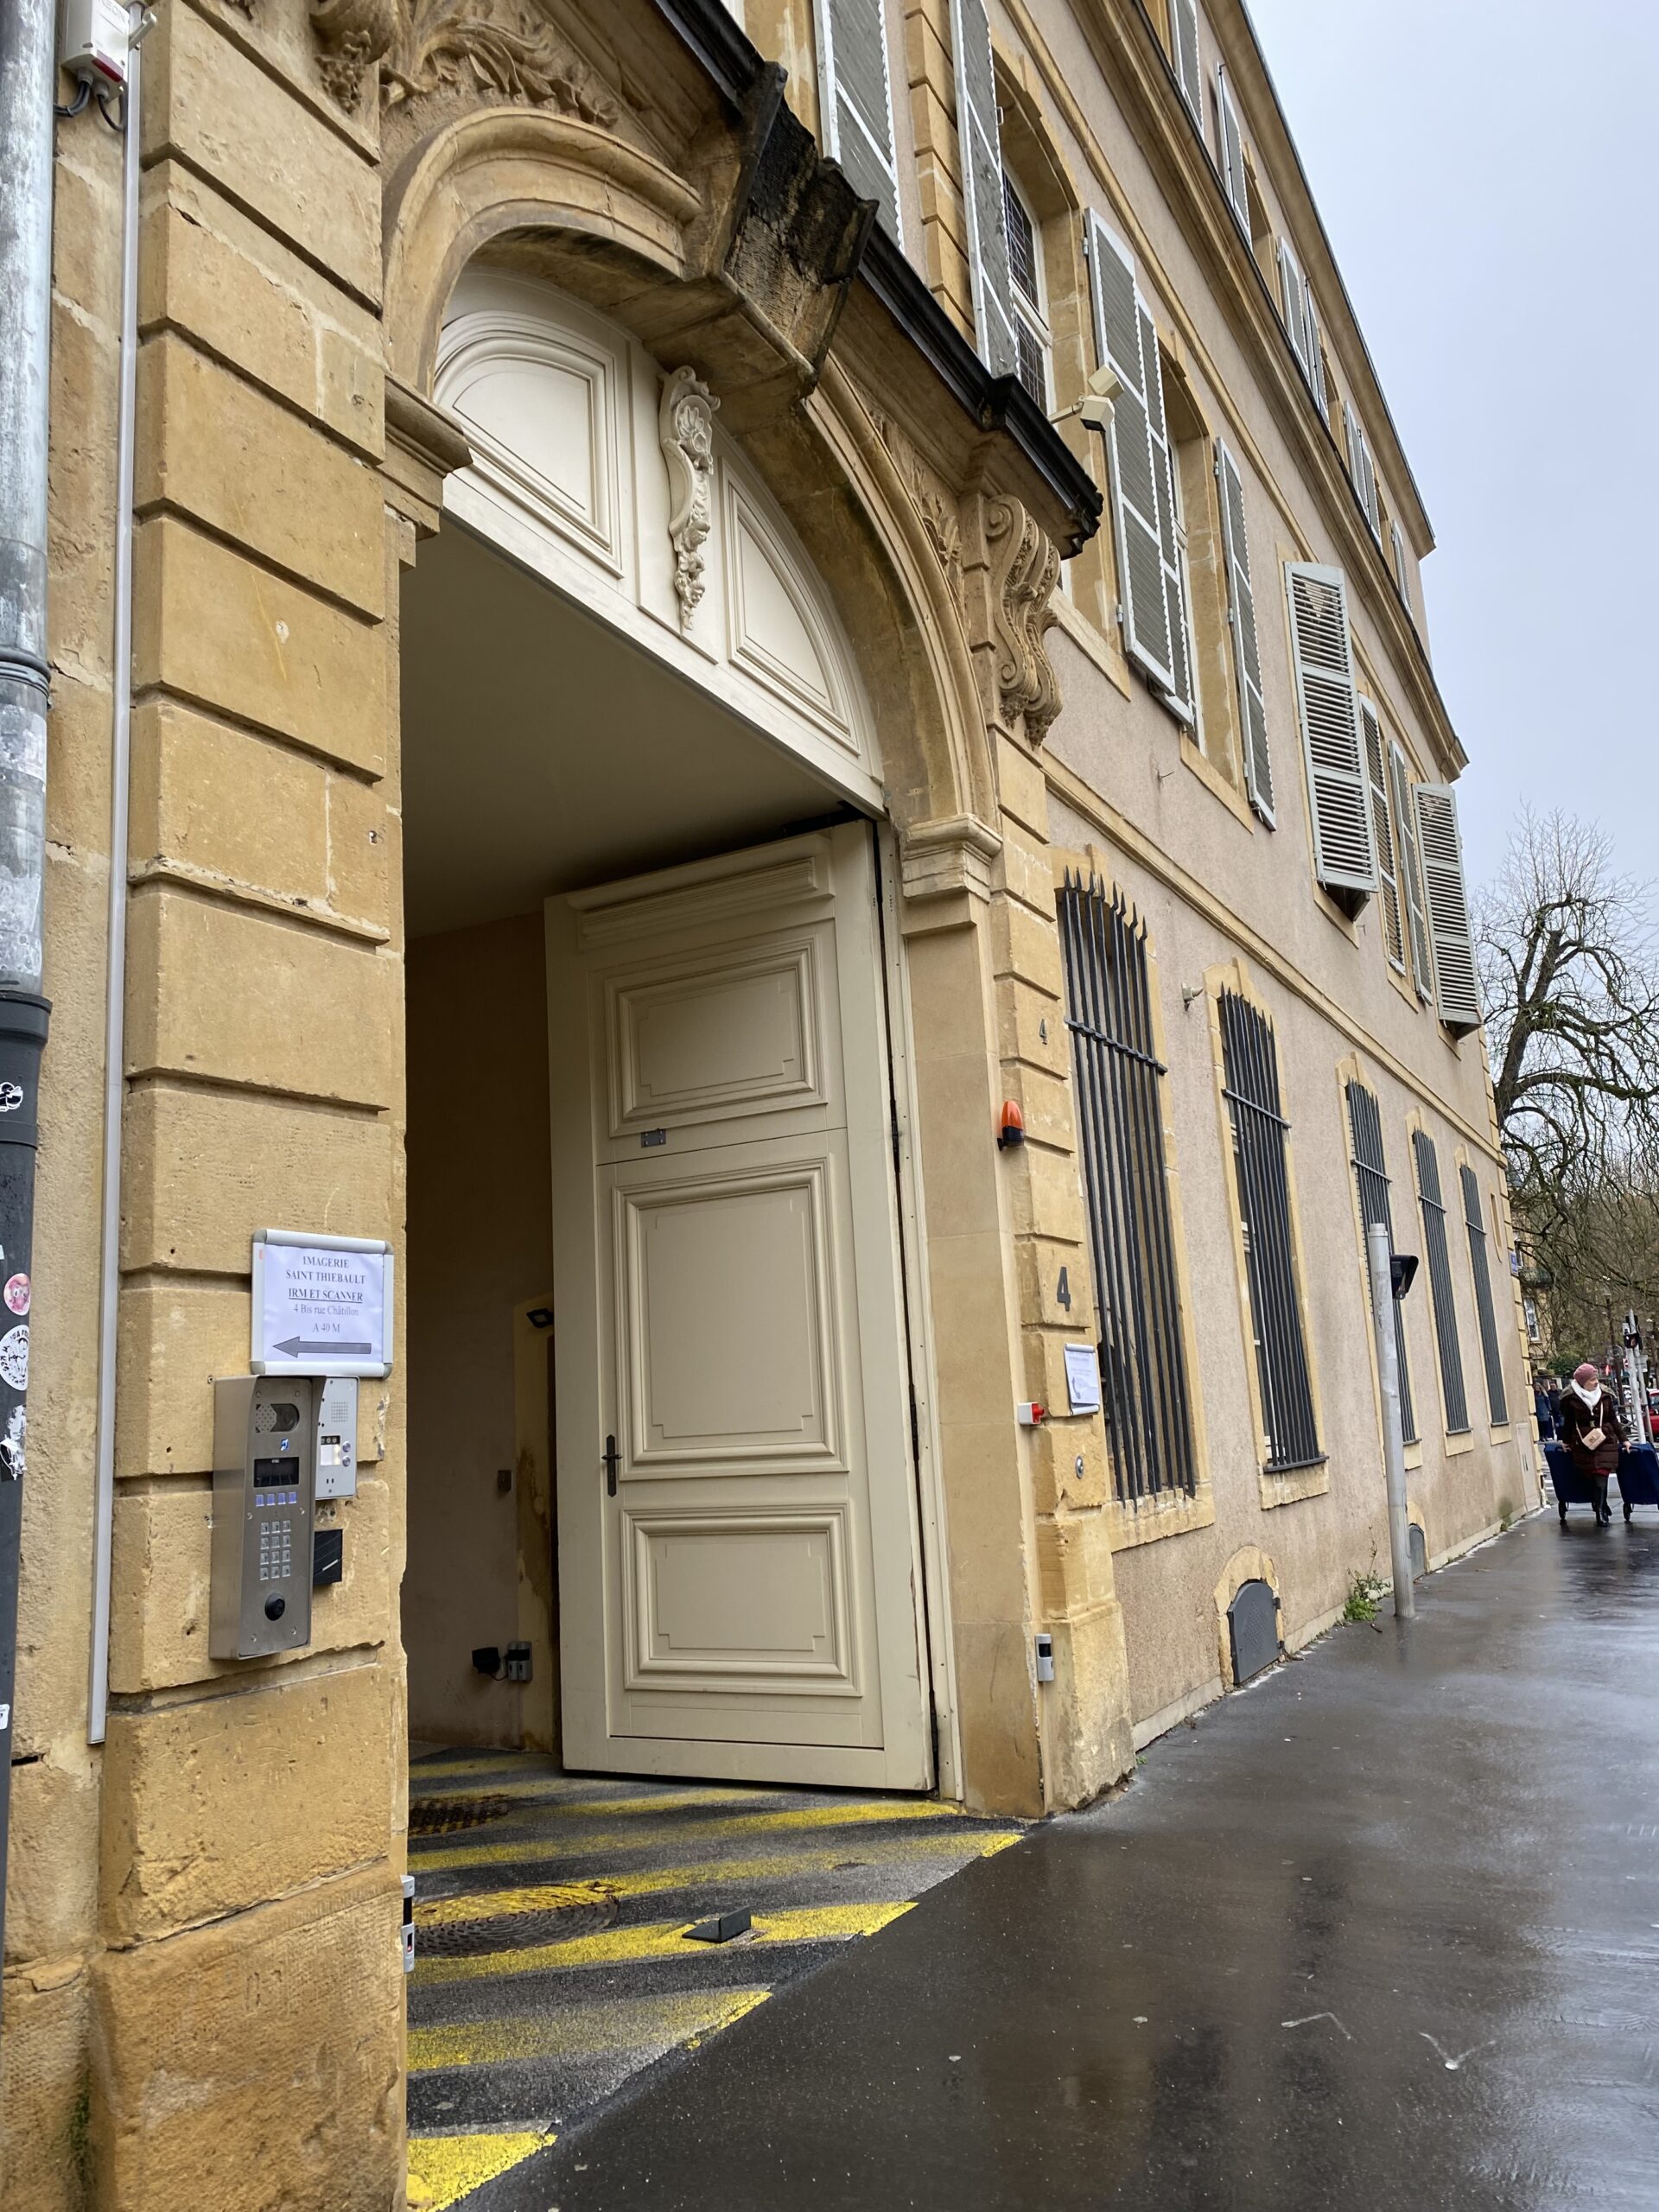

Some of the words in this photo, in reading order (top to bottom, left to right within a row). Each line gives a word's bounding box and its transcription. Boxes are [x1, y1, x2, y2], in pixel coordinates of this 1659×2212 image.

[302, 1255, 350, 1268] IMAGERIE
[285, 1269, 314, 1281] SAINT
[316, 1272, 365, 1284] THIEBAULT
[289, 1287, 307, 1298] IRM
[309, 1289, 321, 1299] ET
[322, 1290, 363, 1301] SCANNER
[1057, 1266, 1071, 1312] 4
[293, 1303, 299, 1313] 4
[301, 1304, 312, 1313] Bis
[327, 1305, 359, 1316] Châtillon
[313, 1323, 320, 1332] A
[321, 1323, 331, 1332] 40
[332, 1323, 340, 1332] M
